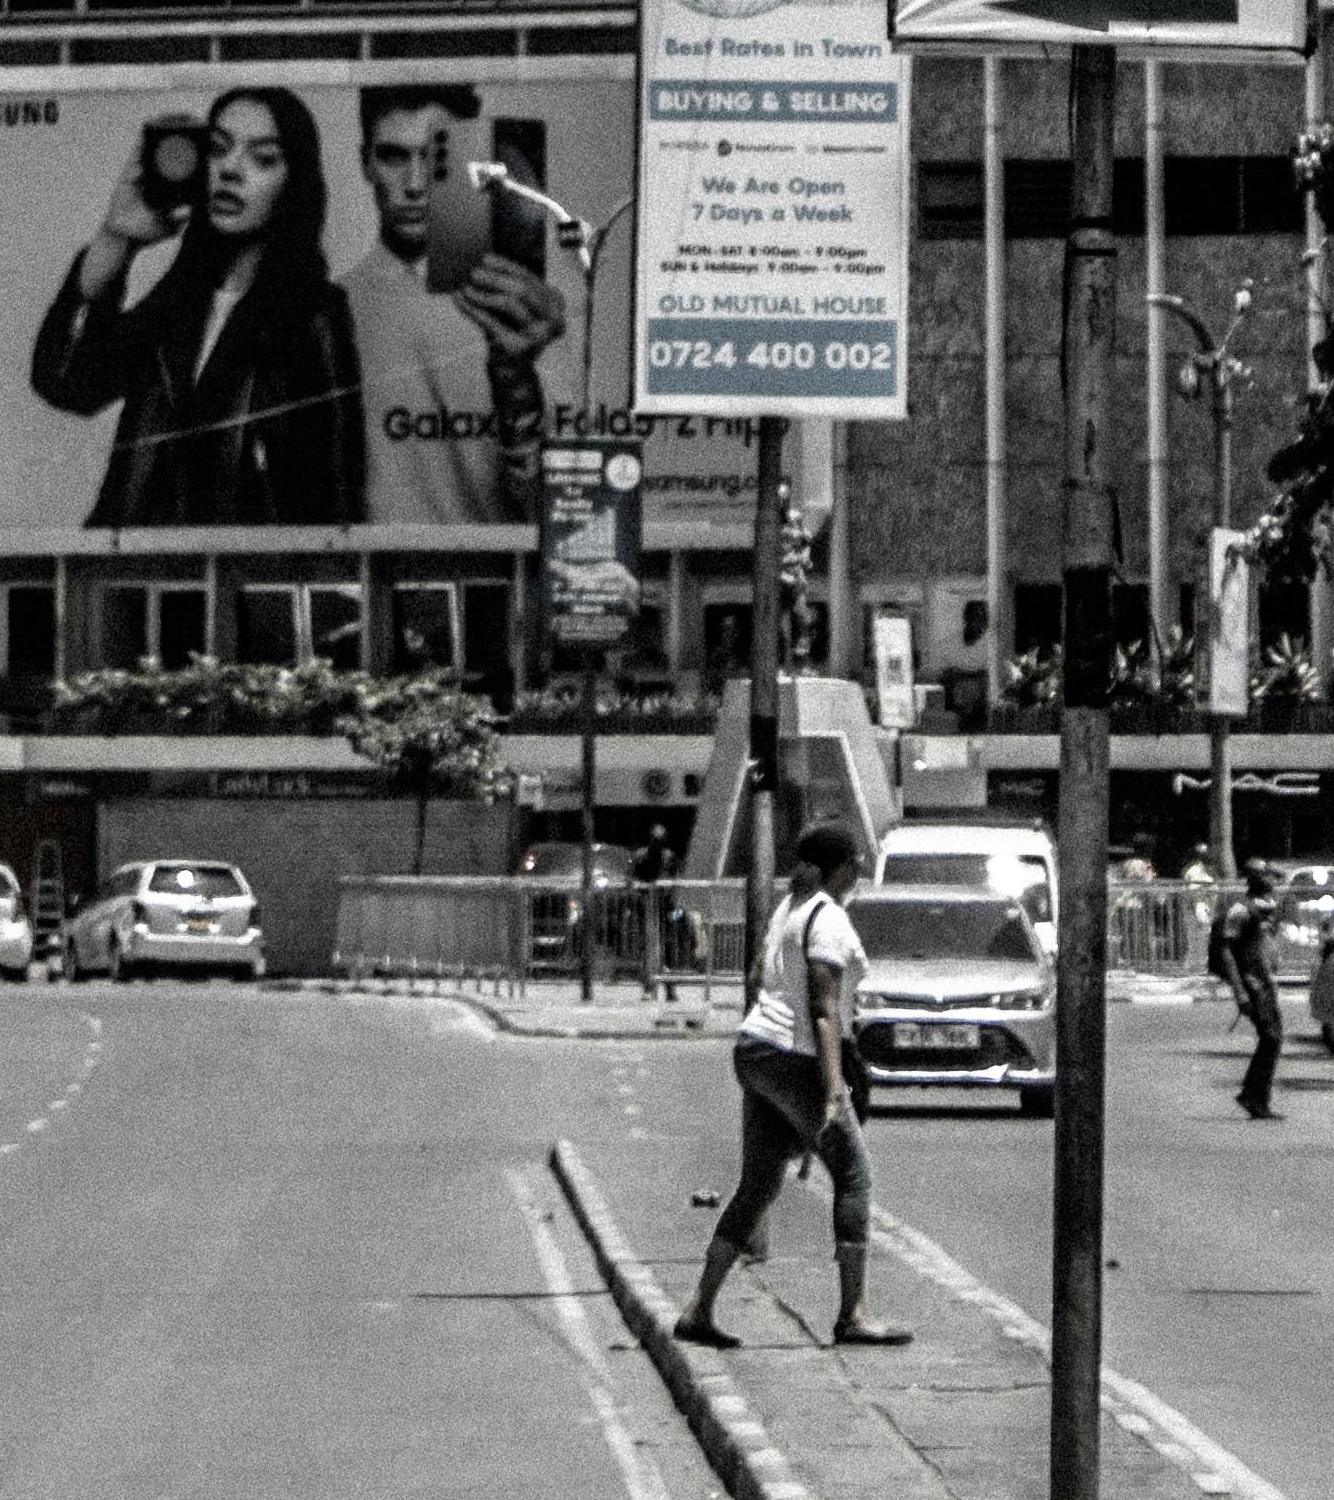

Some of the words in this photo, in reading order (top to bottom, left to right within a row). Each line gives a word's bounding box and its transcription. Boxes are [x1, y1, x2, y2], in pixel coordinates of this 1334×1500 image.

[666, 38, 713, 56] Best
[721, 38, 785, 57] Rates
[821, 39, 882, 58] Town
[658, 91, 753, 112] BUYING
[762, 92, 780, 111] &
[790, 92, 889, 113] SELLING
[701, 177, 736, 195] We
[744, 177, 779, 195] Are
[787, 177, 845, 199] Open
[692, 202, 705, 221] 7
[710, 204, 764, 226] Days
[770, 208, 786, 222] a
[793, 205, 853, 223] Week
[659, 295, 706, 314] OLD
[713, 295, 805, 315] MUTUAL
[813, 296, 887, 316] HOUSE
[650, 341, 737, 368] 0724
[747, 342, 815, 369] 400
[825, 343, 892, 370] 002
